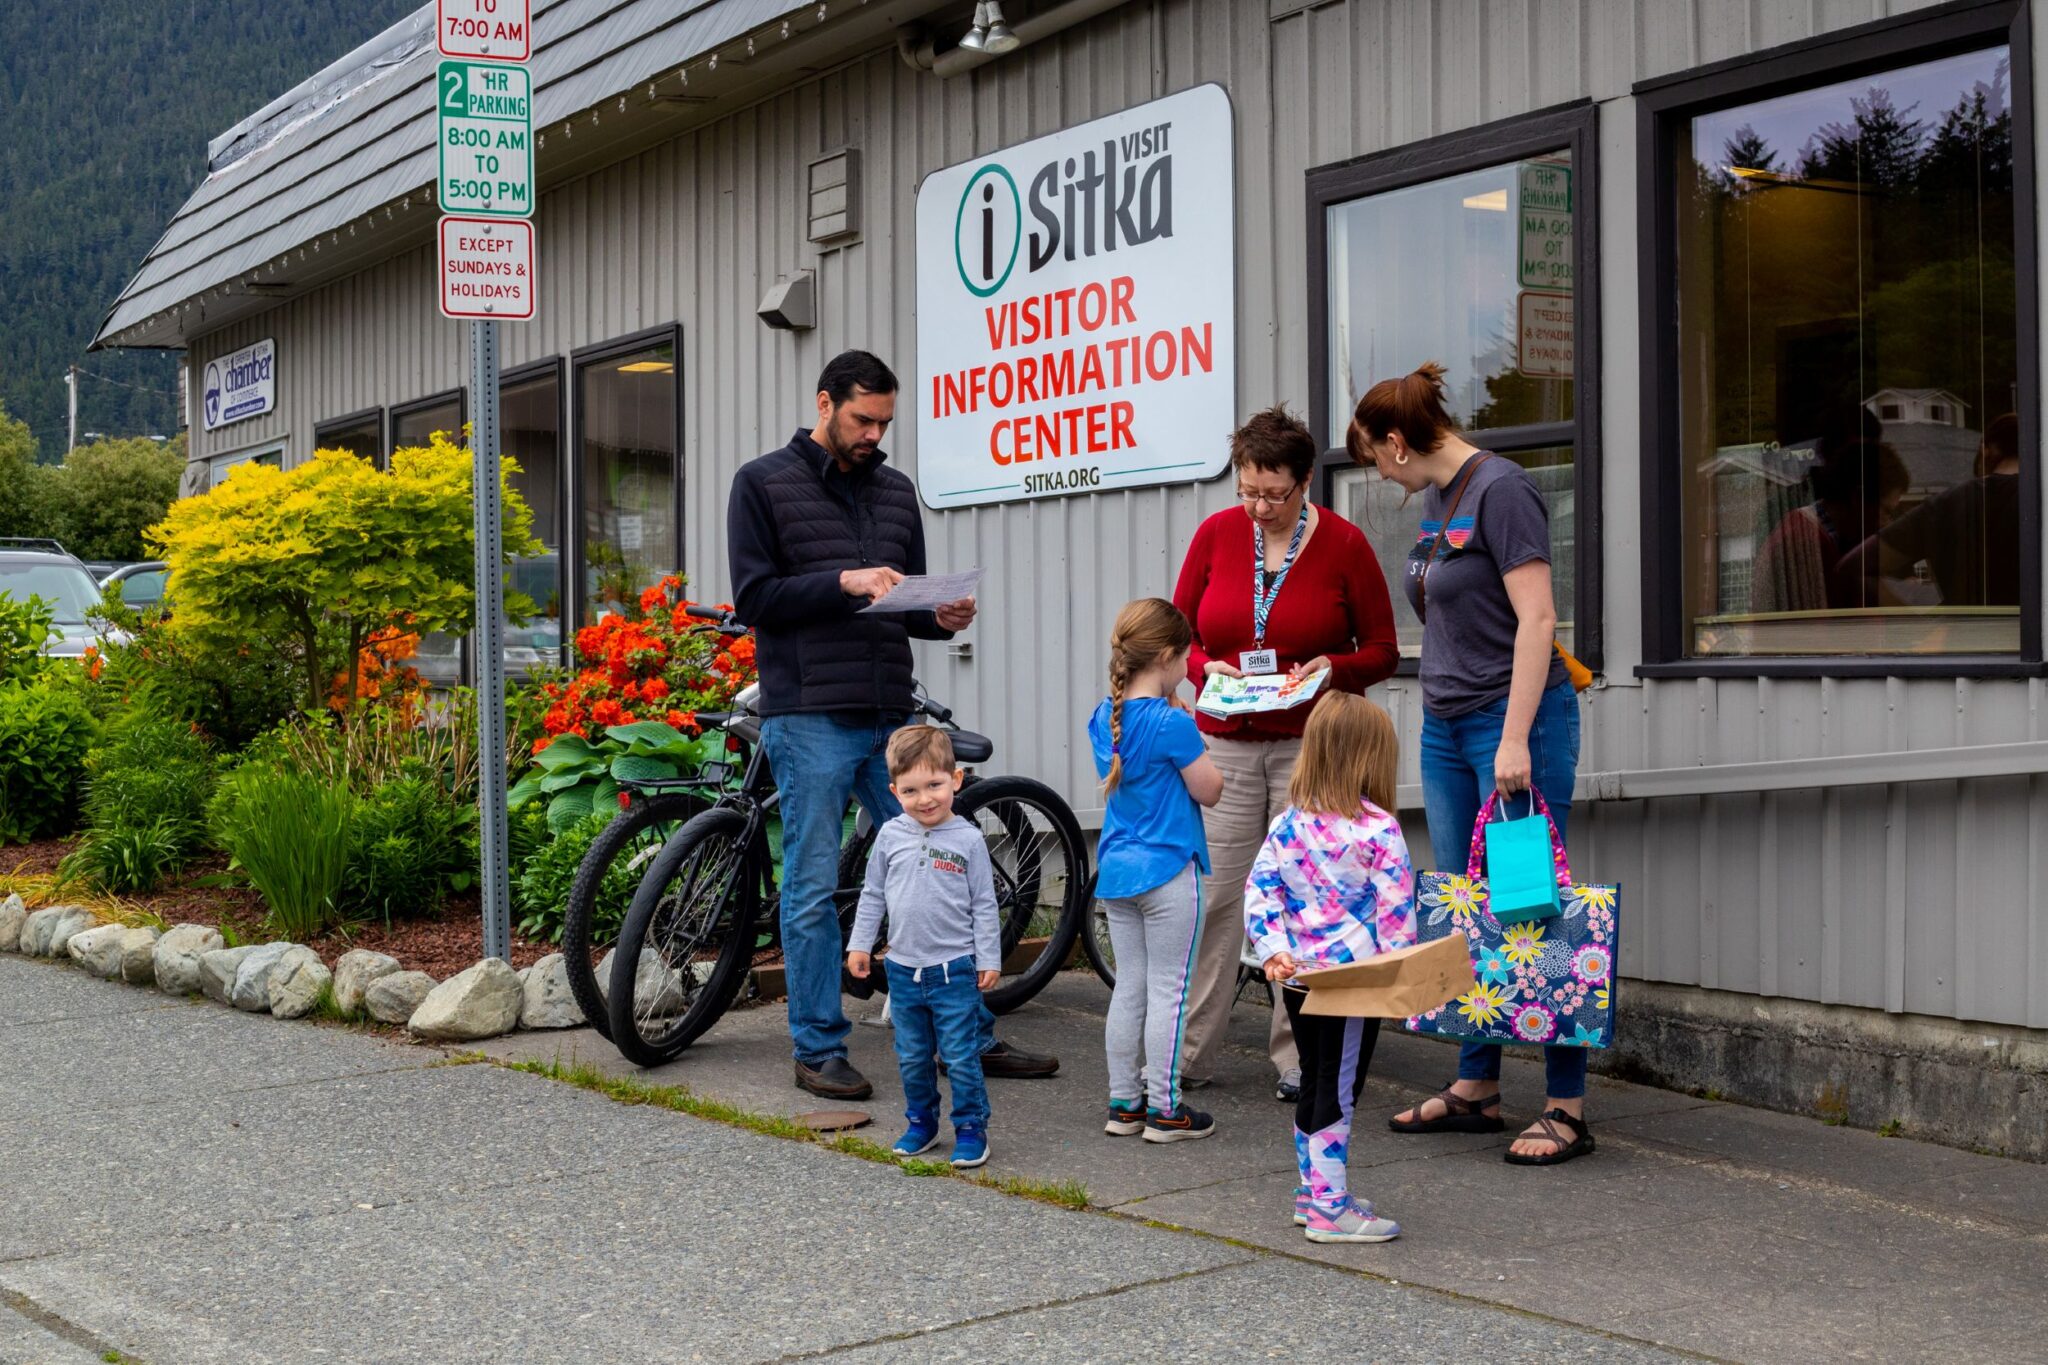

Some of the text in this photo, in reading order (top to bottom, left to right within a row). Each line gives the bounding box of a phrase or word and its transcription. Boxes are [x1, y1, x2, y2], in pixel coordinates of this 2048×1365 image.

[447, 17, 522, 41] 7:00 AM
[444, 71, 509, 109] 2 HR
[470, 94, 526, 116] PARKING
[448, 128, 525, 150] 8:00 AM
[1121, 122, 1172, 163] VISIT
[475, 155, 498, 173] TO
[449, 180, 526, 201] 5:00 PM
[1028, 139, 1173, 273] Sitka
[459, 237, 513, 253] EXCEPT
[448, 260, 526, 276] SUNDAYS &
[451, 283, 520, 299] HOLIDAYS
[985, 275, 1137, 351] VISITOR
[225, 348, 272, 393] chamber
[932, 322, 1213, 419] INFORMATION
[990, 400, 1138, 466] CENTER
[1025, 467, 1100, 493] SITKA.ORG
[1248, 656, 1270, 666] Sitka
